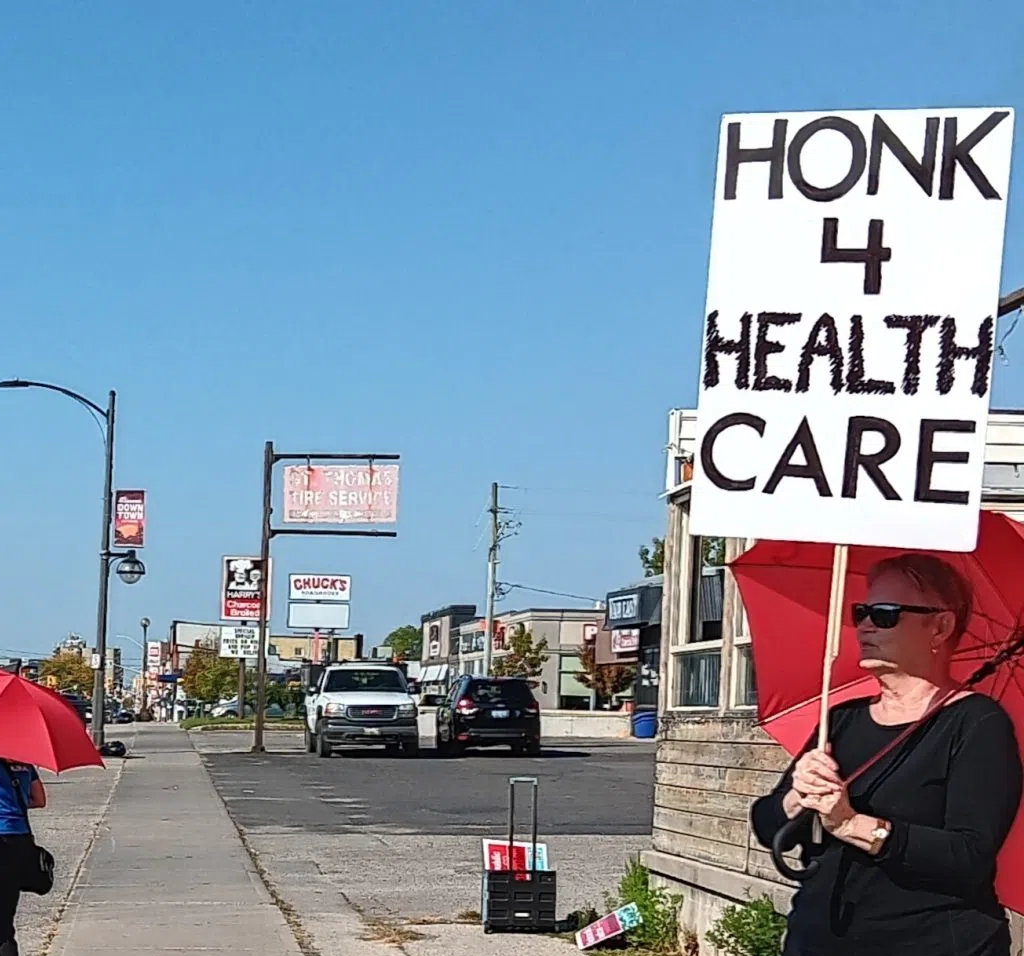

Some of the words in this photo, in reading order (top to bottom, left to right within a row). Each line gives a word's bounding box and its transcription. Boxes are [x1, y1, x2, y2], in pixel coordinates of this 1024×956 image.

[723, 111, 1010, 202] HONK
[820, 217, 891, 295] 4
[703, 310, 994, 399] HEALTH
[700, 412, 977, 505] CARE
[117, 503, 144, 512] DOWN
[117, 511, 144, 520] TOWN
[293, 577, 347, 591] CHUCK'S
